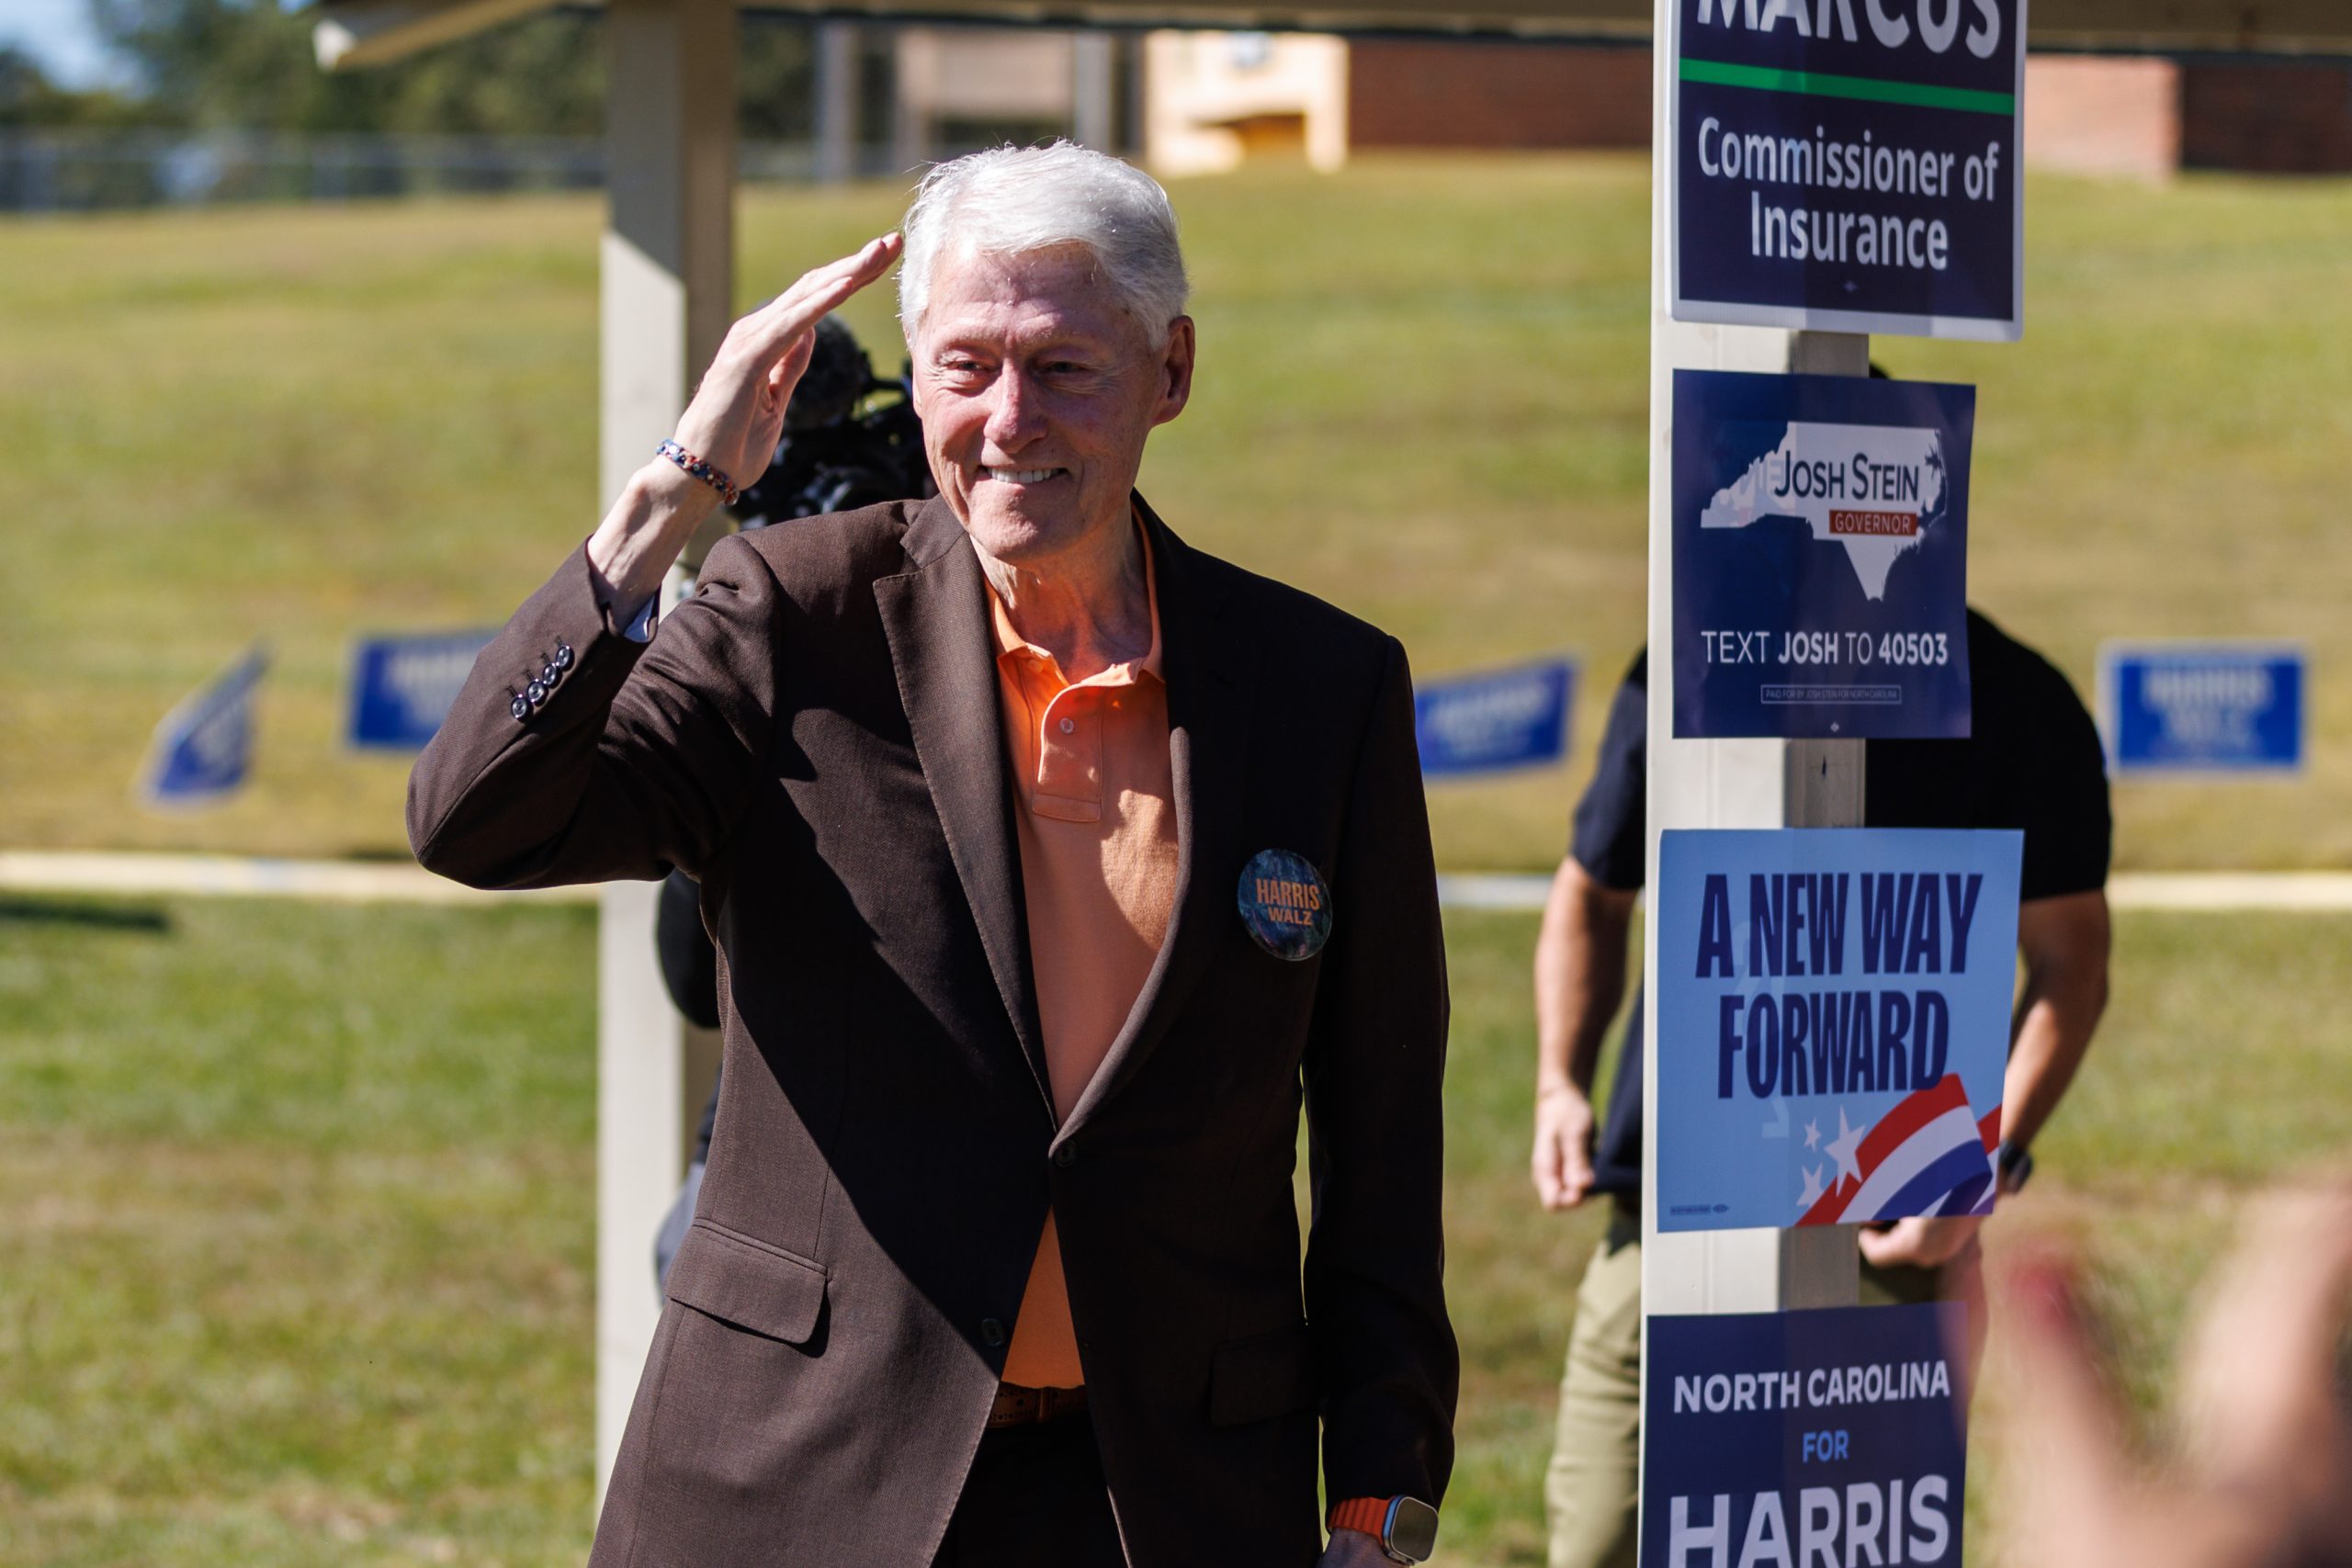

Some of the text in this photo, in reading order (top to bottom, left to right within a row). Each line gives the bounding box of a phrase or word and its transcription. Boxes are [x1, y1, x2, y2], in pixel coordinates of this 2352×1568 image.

[1698, 117, 2000, 201] Commissioner of
[1751, 190, 1948, 270] Insurance
[1774, 450, 1919, 502] JOSH STEIN
[1835, 513, 1911, 534] GOVERNOR
[1701, 631, 1948, 665] TEXT JOSH TO 40503
[1256, 879, 1321, 911] HARRIS
[1268, 907, 1313, 926] WALZ
[1695, 873, 1984, 978] A NEW WAY
[1718, 990, 1949, 1099] FORWARD
[1674, 1360, 1951, 1414] NORTH CAROLINA
[1803, 1430, 1849, 1462] FOR
[1668, 1474, 1950, 1568] HARRIS
